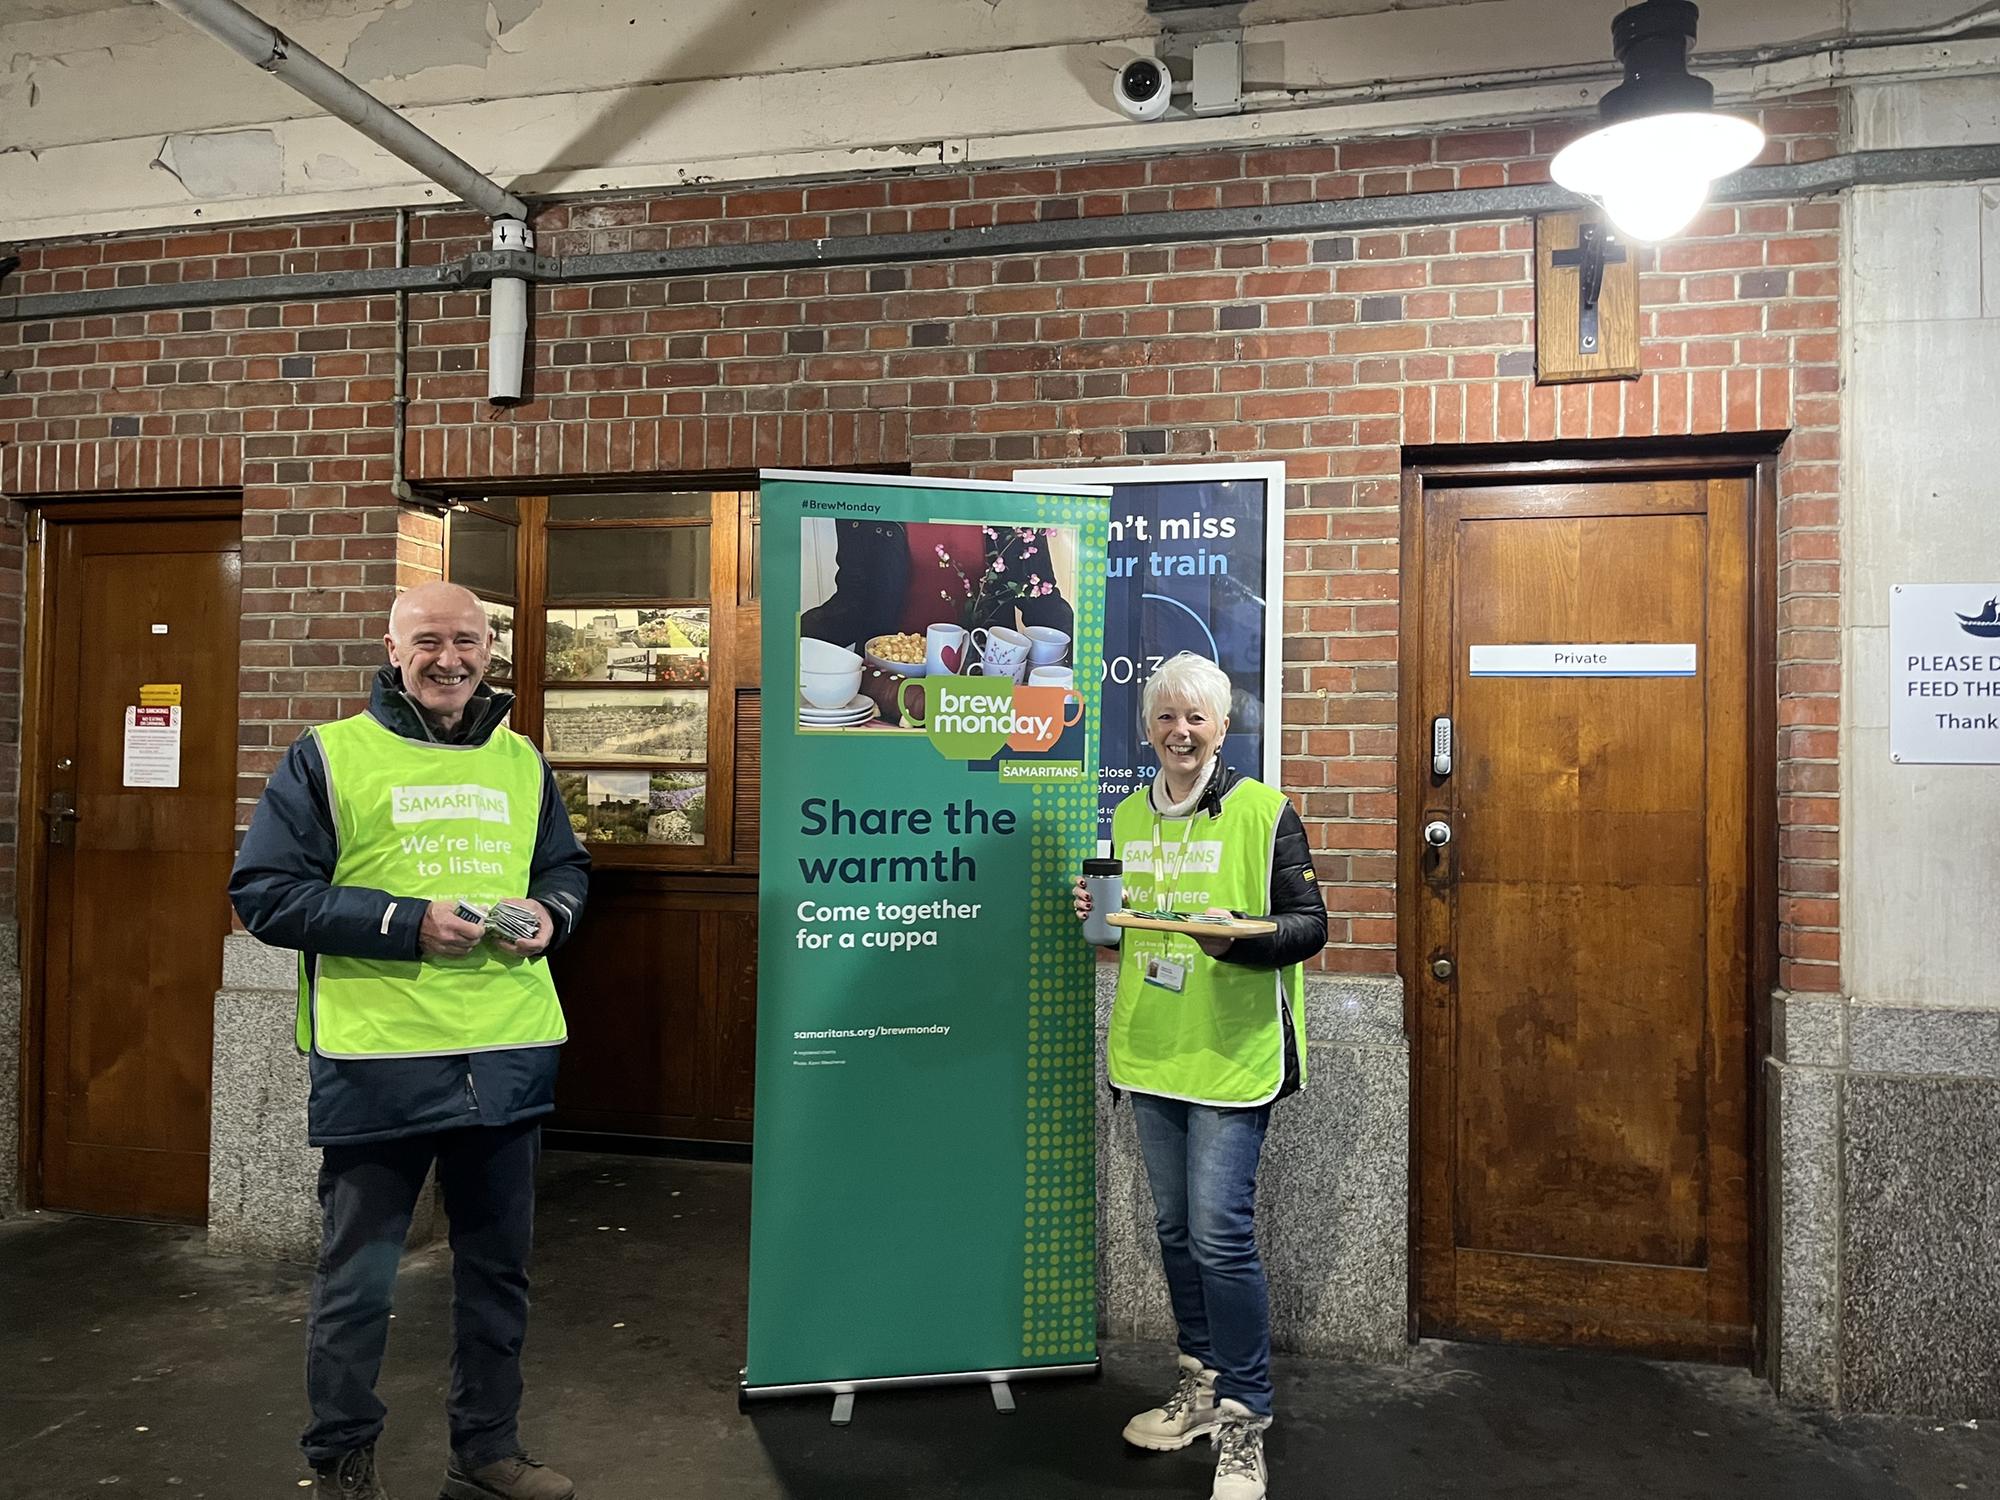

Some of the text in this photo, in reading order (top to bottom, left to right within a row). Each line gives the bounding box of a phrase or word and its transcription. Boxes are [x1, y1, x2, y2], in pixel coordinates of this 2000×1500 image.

[802, 500, 881, 514] #BrewMonday
[1108, 512, 1237, 541] n't miss
[1106, 549, 1228, 577] ur train
[1554, 653, 1608, 664] Private
[1908, 656, 1983, 671] PLEASE
[1908, 681, 2000, 697] FEED THE
[940, 688, 1013, 713] brew
[1935, 713, 1999, 729] Thank
[1003, 766, 1079, 777] SAMARITANS
[1098, 766, 1156, 778] close 30
[1098, 782, 1130, 793] efore
[399, 794, 505, 813] SAMARITANS
[800, 798, 1016, 836] Share the
[400, 832, 512, 854] We're here
[416, 856, 504, 876] to listen
[798, 847, 976, 883] warmth
[797, 899, 982, 924] Come together
[796, 929, 937, 951] for a cuppa
[793, 1024, 950, 1039] samaritans.org/brewmonday
